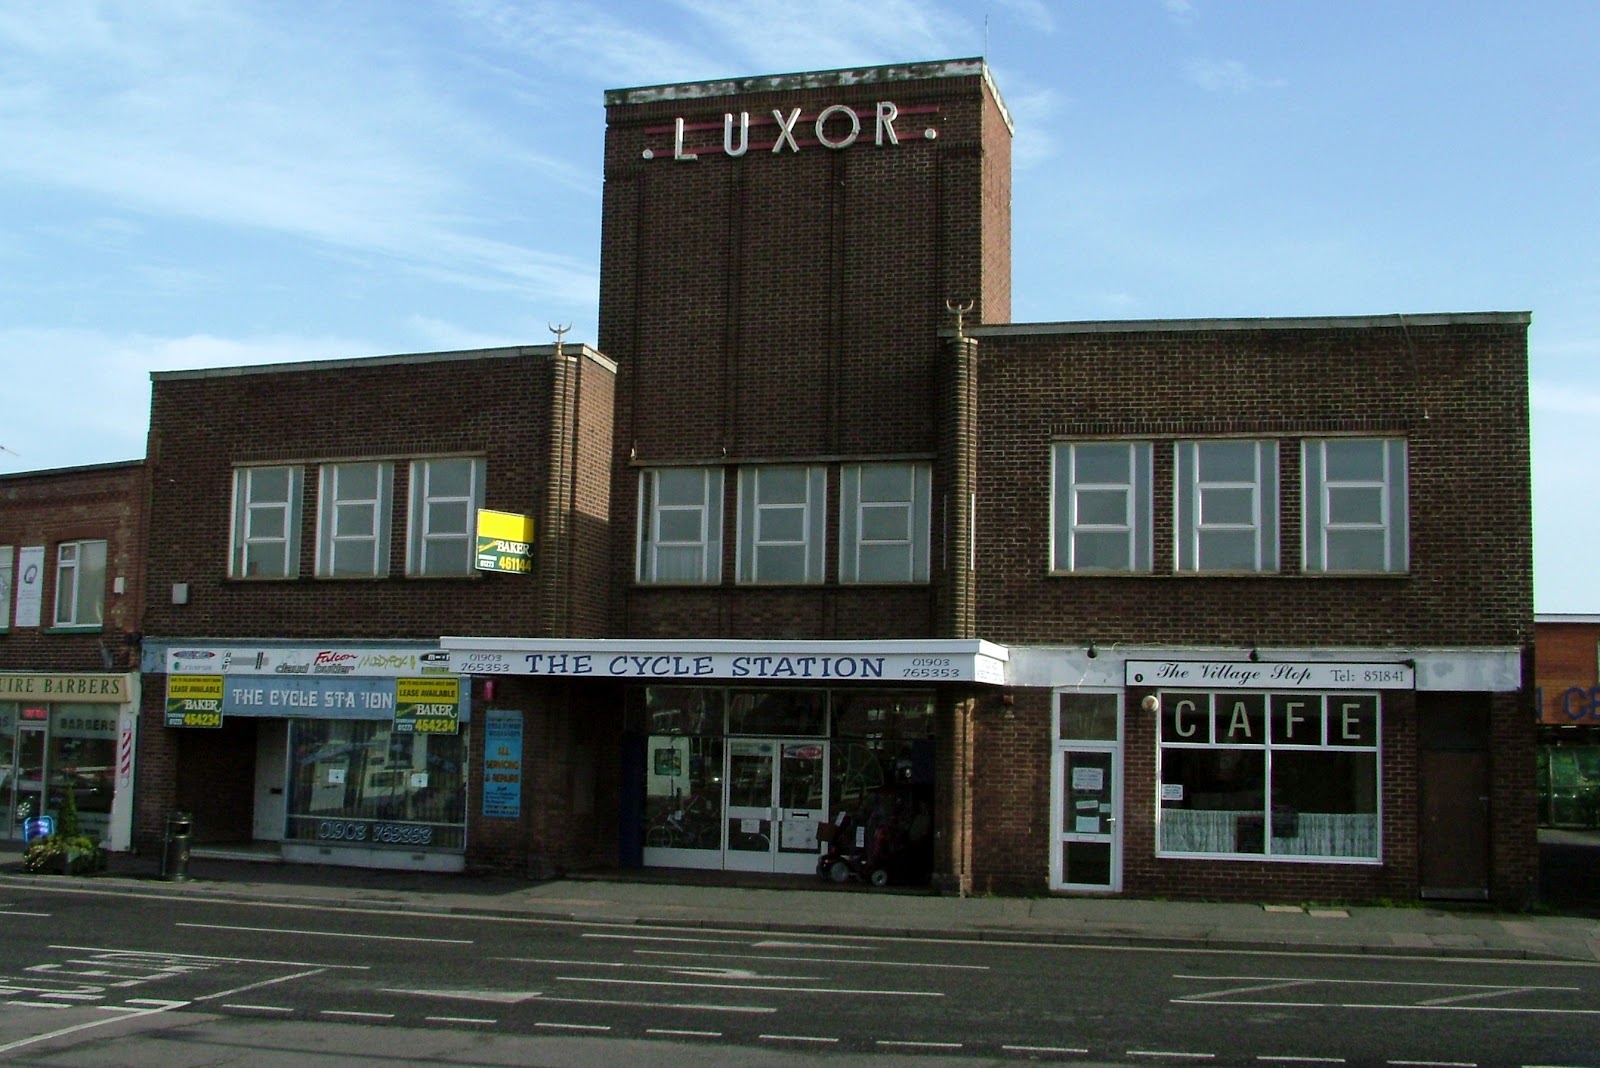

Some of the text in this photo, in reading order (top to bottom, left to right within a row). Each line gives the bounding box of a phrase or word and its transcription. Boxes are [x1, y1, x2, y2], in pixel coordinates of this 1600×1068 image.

[674, 101, 899, 161] LUXOR
[496, 540, 533, 557] BAKER
[469, 654, 503, 662] 01903
[912, 658, 951, 667] 01903
[461, 663, 510, 672] 765353
[525, 654, 886, 679] THE CYCLE STATION
[903, 668, 960, 678] 765353
[1156, 662, 1189, 680] The
[1200, 663, 1261, 687] Village
[1330, 669, 1355, 682] Tel:
[1364, 670, 1404, 682] 851841
[44, 678, 120, 695] BARBERS
[400, 689, 456, 698] LEASE AVAILABLE
[232, 688, 263, 706] THE
[269, 690, 318, 707] CYCLE
[184, 699, 222, 713] BAKER
[415, 703, 458, 718] BAKER
[415, 718, 456, 732] 454234
[1175, 699, 1361, 740] CAFE
[320, 821, 433, 844] 01903 765353
